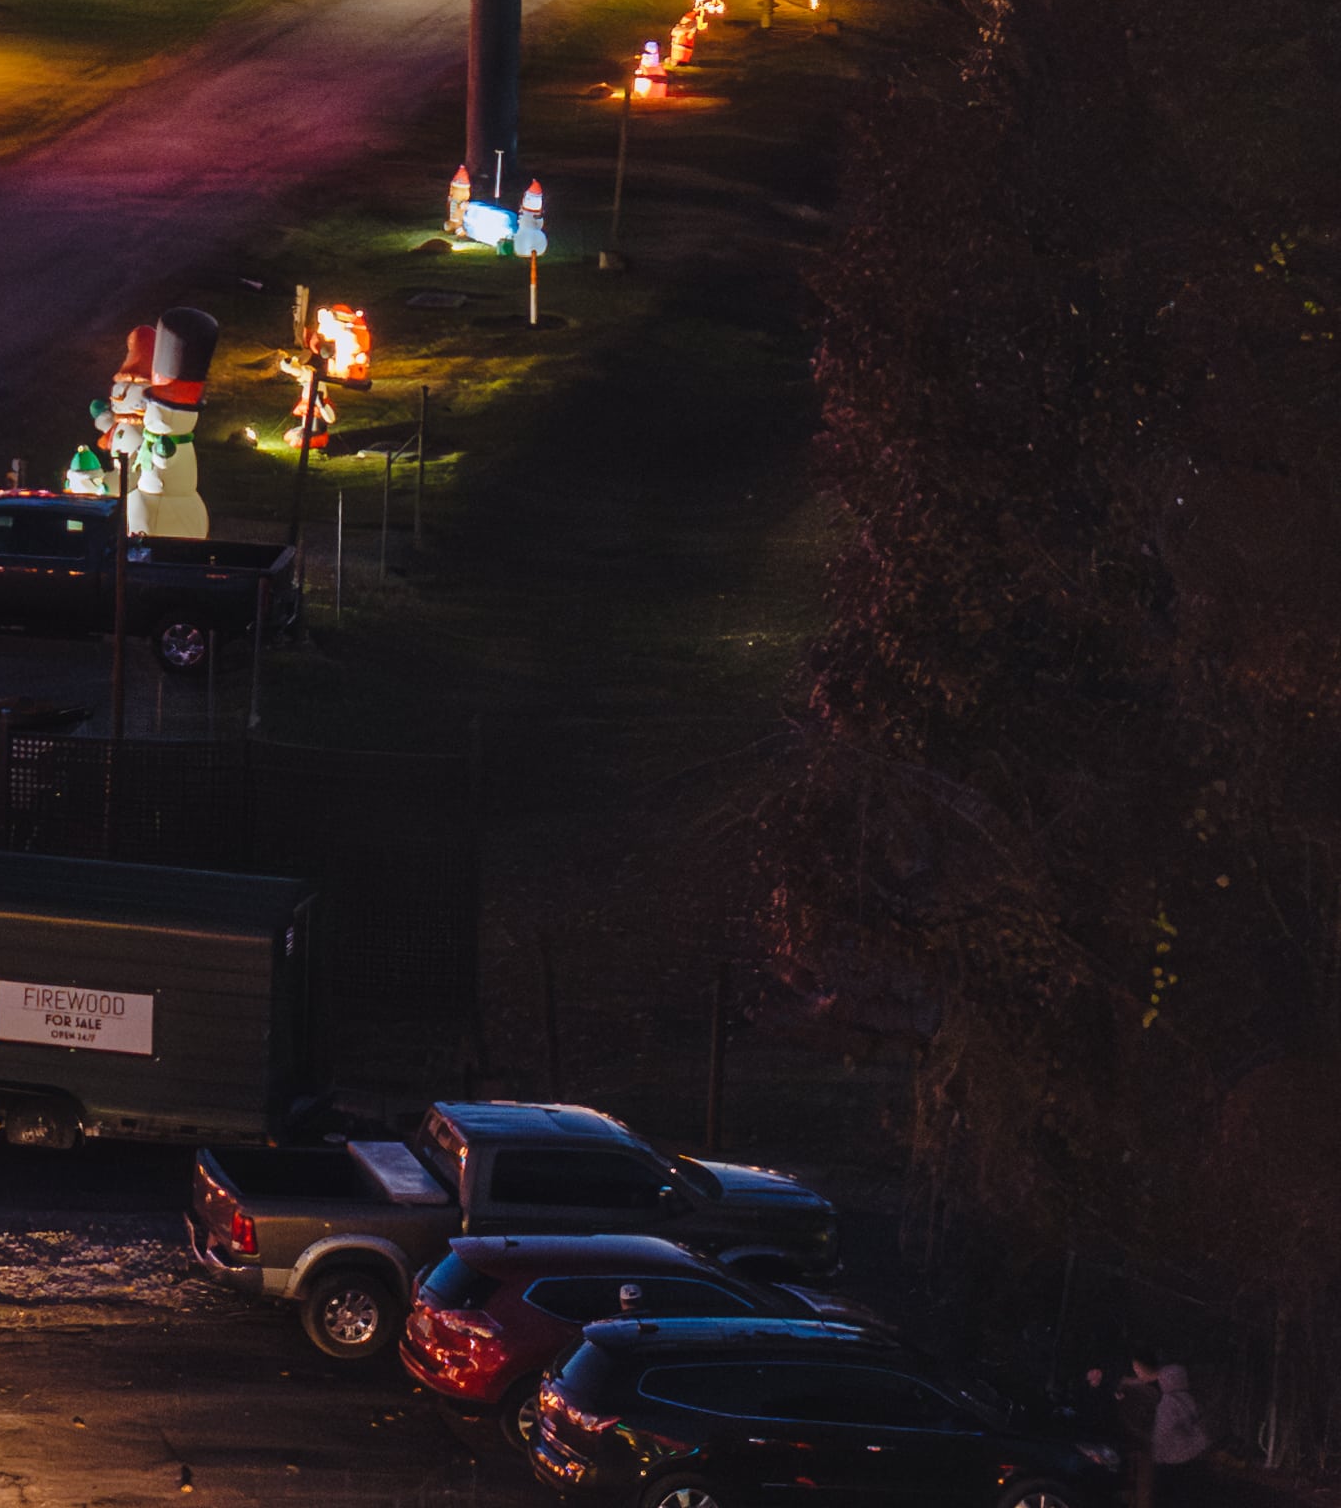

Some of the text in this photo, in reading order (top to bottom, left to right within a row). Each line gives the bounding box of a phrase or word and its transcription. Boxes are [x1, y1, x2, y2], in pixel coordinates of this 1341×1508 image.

[23, 987, 125, 1016] FIREWOOD
[45, 1014, 102, 1030] FOR SALE
[50, 1030, 75, 1040] OPEN
